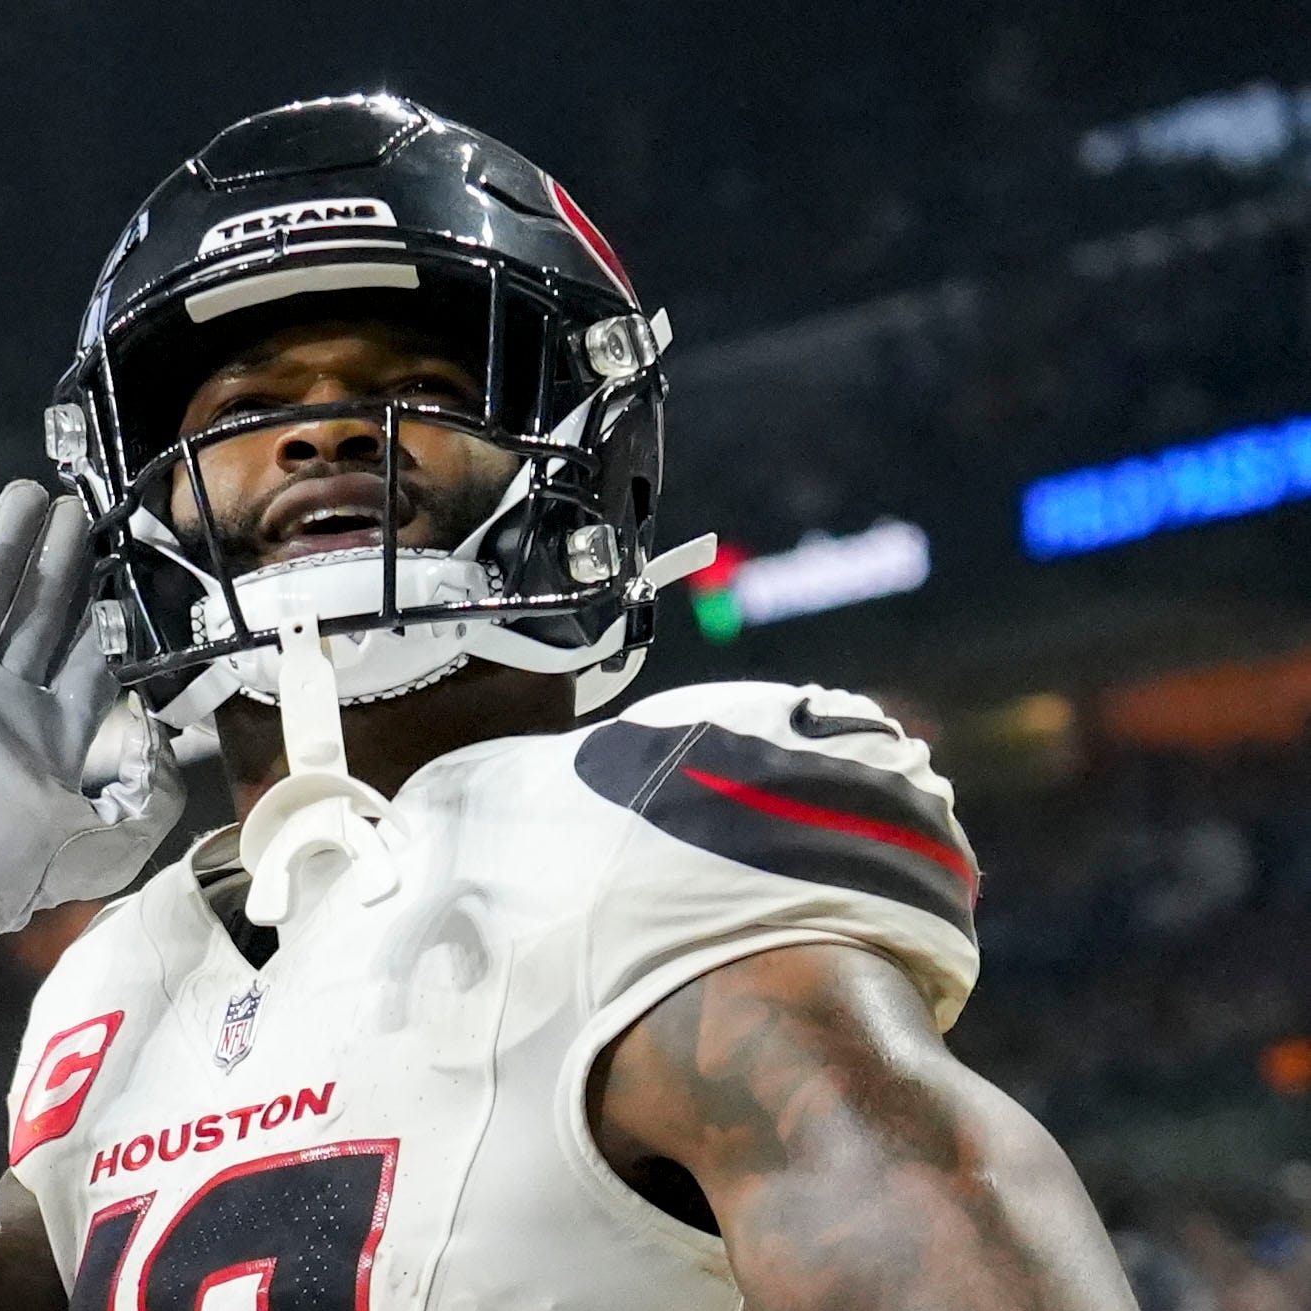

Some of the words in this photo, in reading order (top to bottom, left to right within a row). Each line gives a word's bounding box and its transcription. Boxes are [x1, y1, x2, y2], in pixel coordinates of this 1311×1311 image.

[216, 204, 378, 241] TEXANS
[23, 1020, 109, 1123] C
[220, 1020, 249, 1056] NFL
[89, 1081, 337, 1185] HOUSTON
